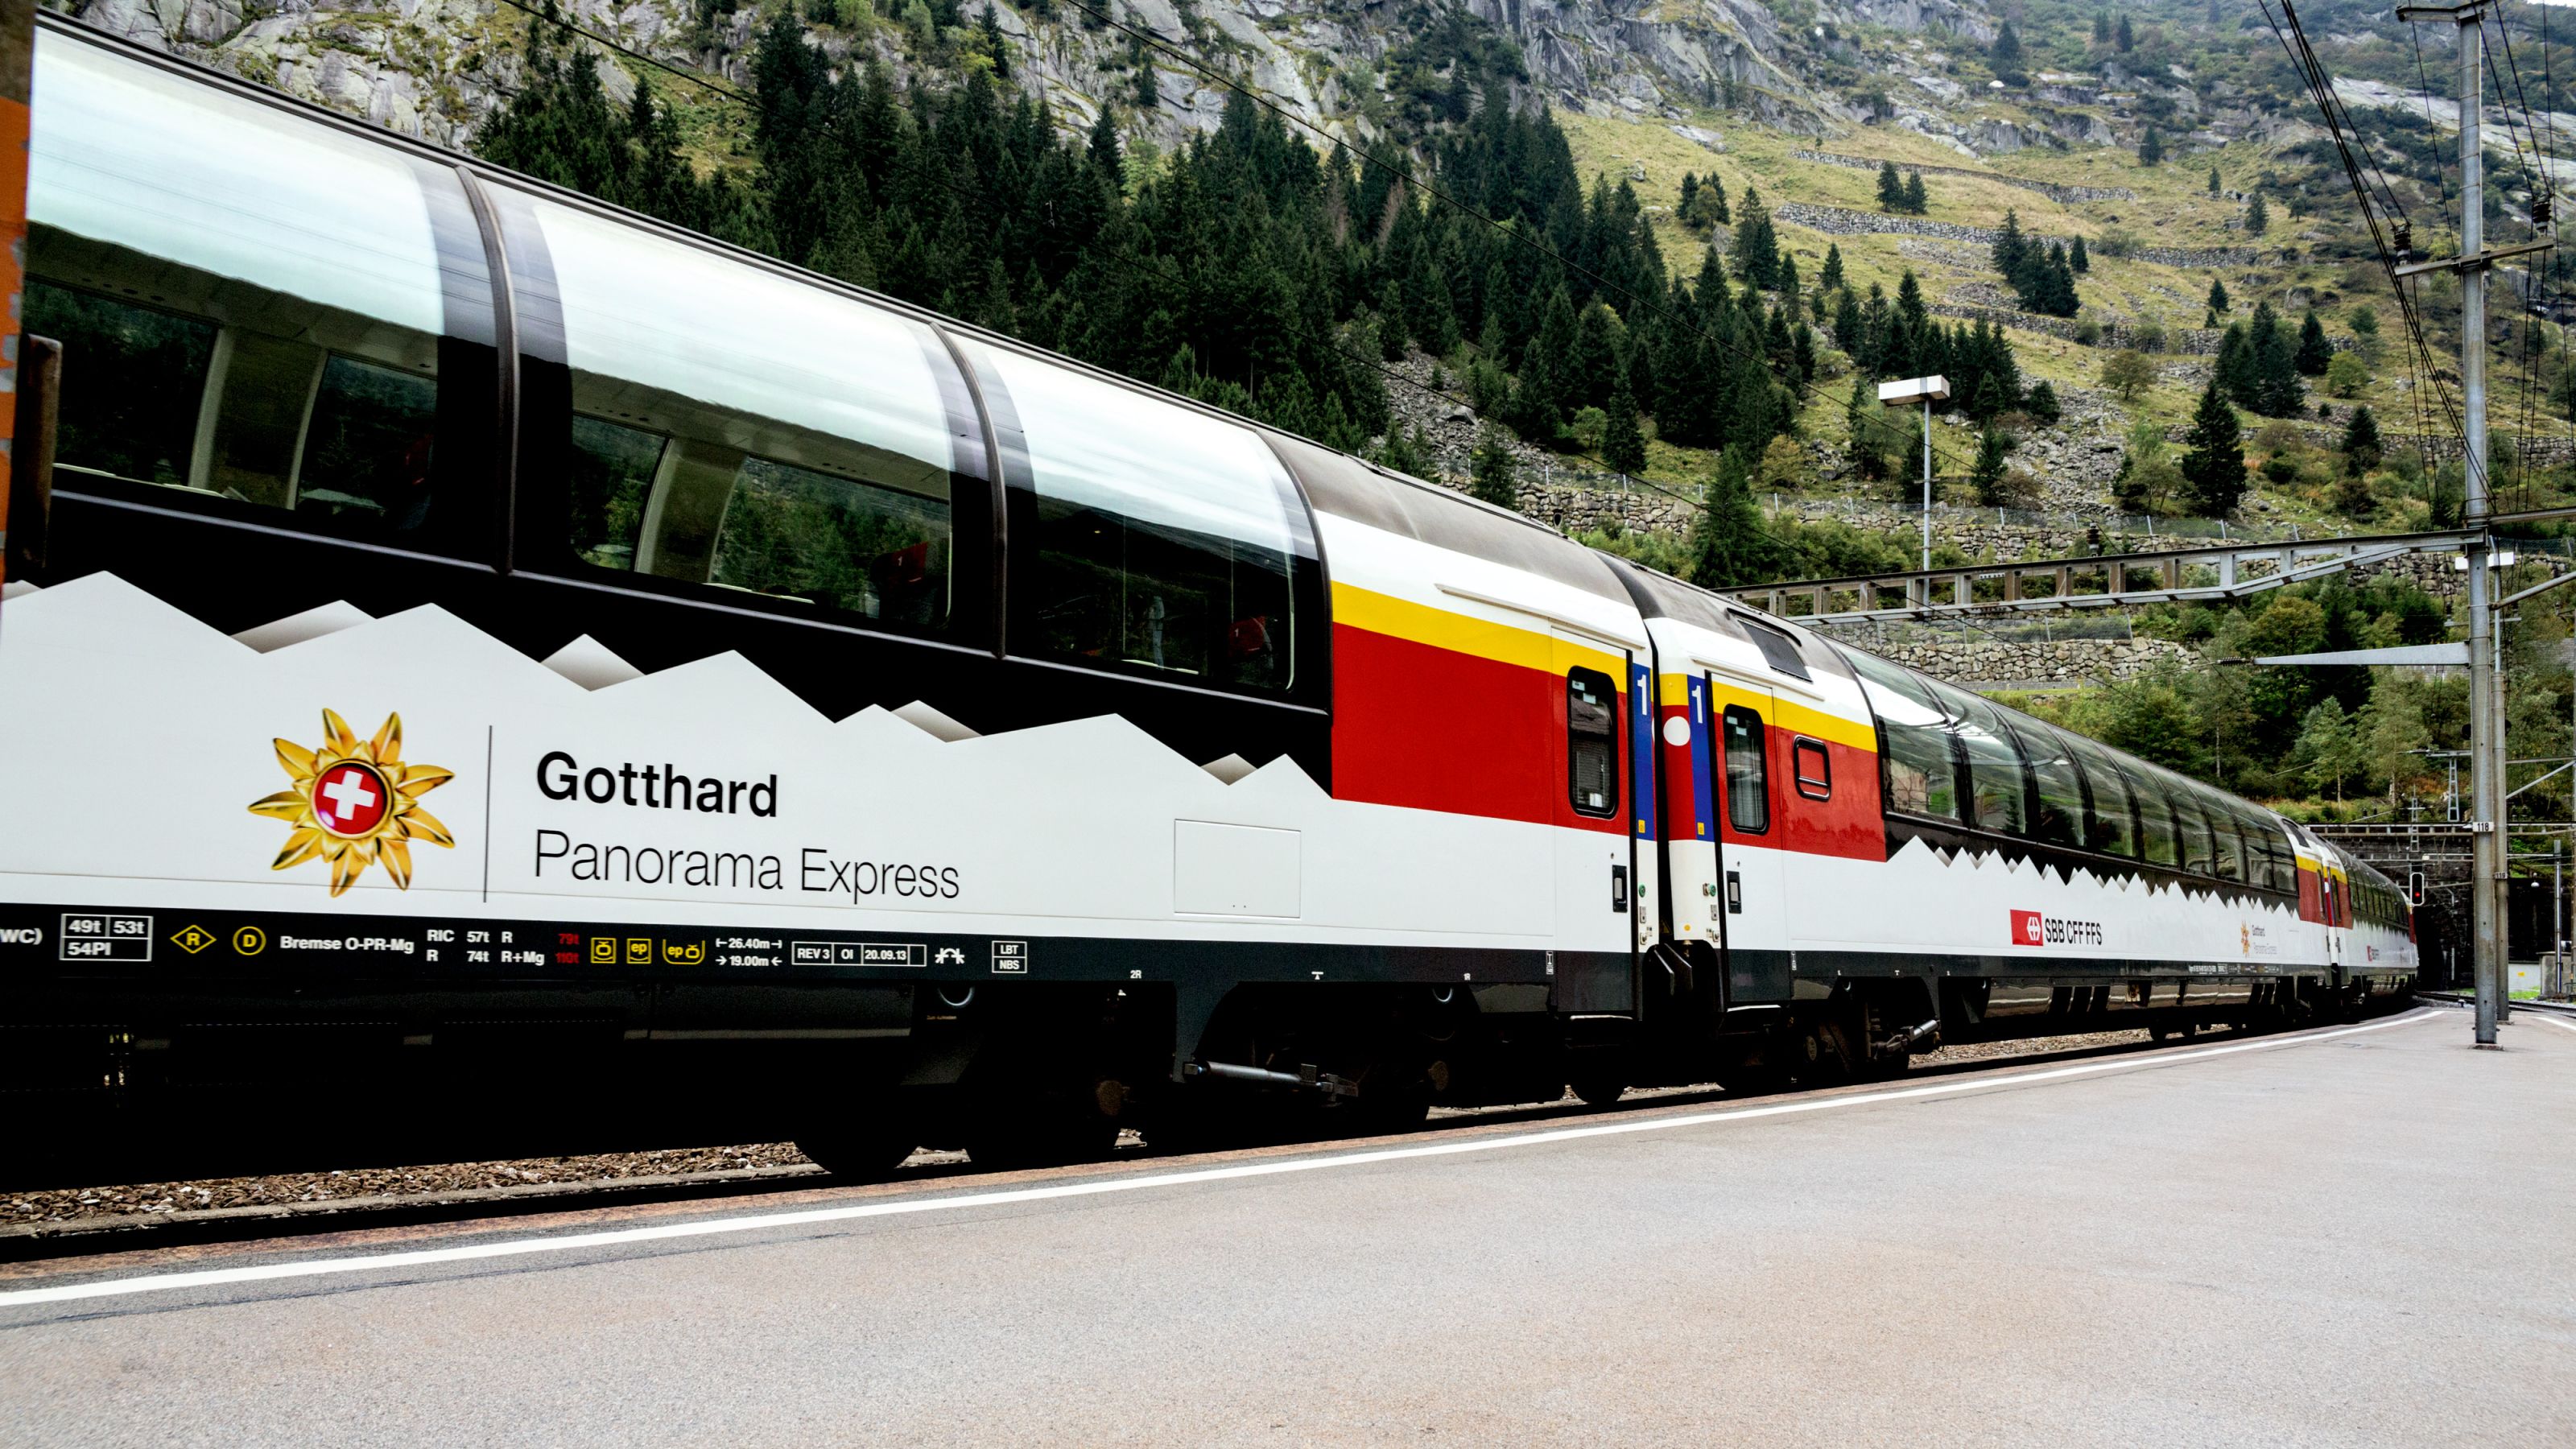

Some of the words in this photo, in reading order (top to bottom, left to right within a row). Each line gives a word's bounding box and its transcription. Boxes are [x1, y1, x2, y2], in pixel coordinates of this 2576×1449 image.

[898, 555, 902, 567] 1
[1637, 674, 1647, 716] 1
[1692, 685, 1703, 724] 1
[537, 751, 777, 817] Gotthard
[2477, 822, 2489, 832] 118
[535, 829, 783, 890] Panorama
[801, 848, 960, 905] Express
[68, 920, 101, 933] 49t
[113, 920, 145, 934] 53t
[2045, 918, 2065, 943] SBB
[2066, 920, 2083, 944] CFF
[2085, 922, 2103, 946] FFS
[186, 932, 200, 946] R
[242, 935, 257, 947] D
[427, 929, 455, 943] RIC
[466, 931, 490, 943] 57t
[502, 931, 514, 943] R
[280, 935, 342, 950] Bremse
[345, 937, 415, 955] O-PR-Mg
[631, 943, 647, 955] ep
[728, 937, 770, 949] 26.40m
[667, 946, 683, 958] ep
[797, 948, 821, 959] REV
[822, 949, 831, 960] 3
[865, 950, 906, 960] 20.09.13
[1000, 944, 1019, 955] LBT
[426, 949, 439, 962] R
[466, 950, 489, 963] 74t
[501, 950, 545, 966] R+Mg
[729, 956, 770, 967] 19.00m
[999, 960, 1020, 970] NBS
[1129, 969, 1142, 979] 2R
